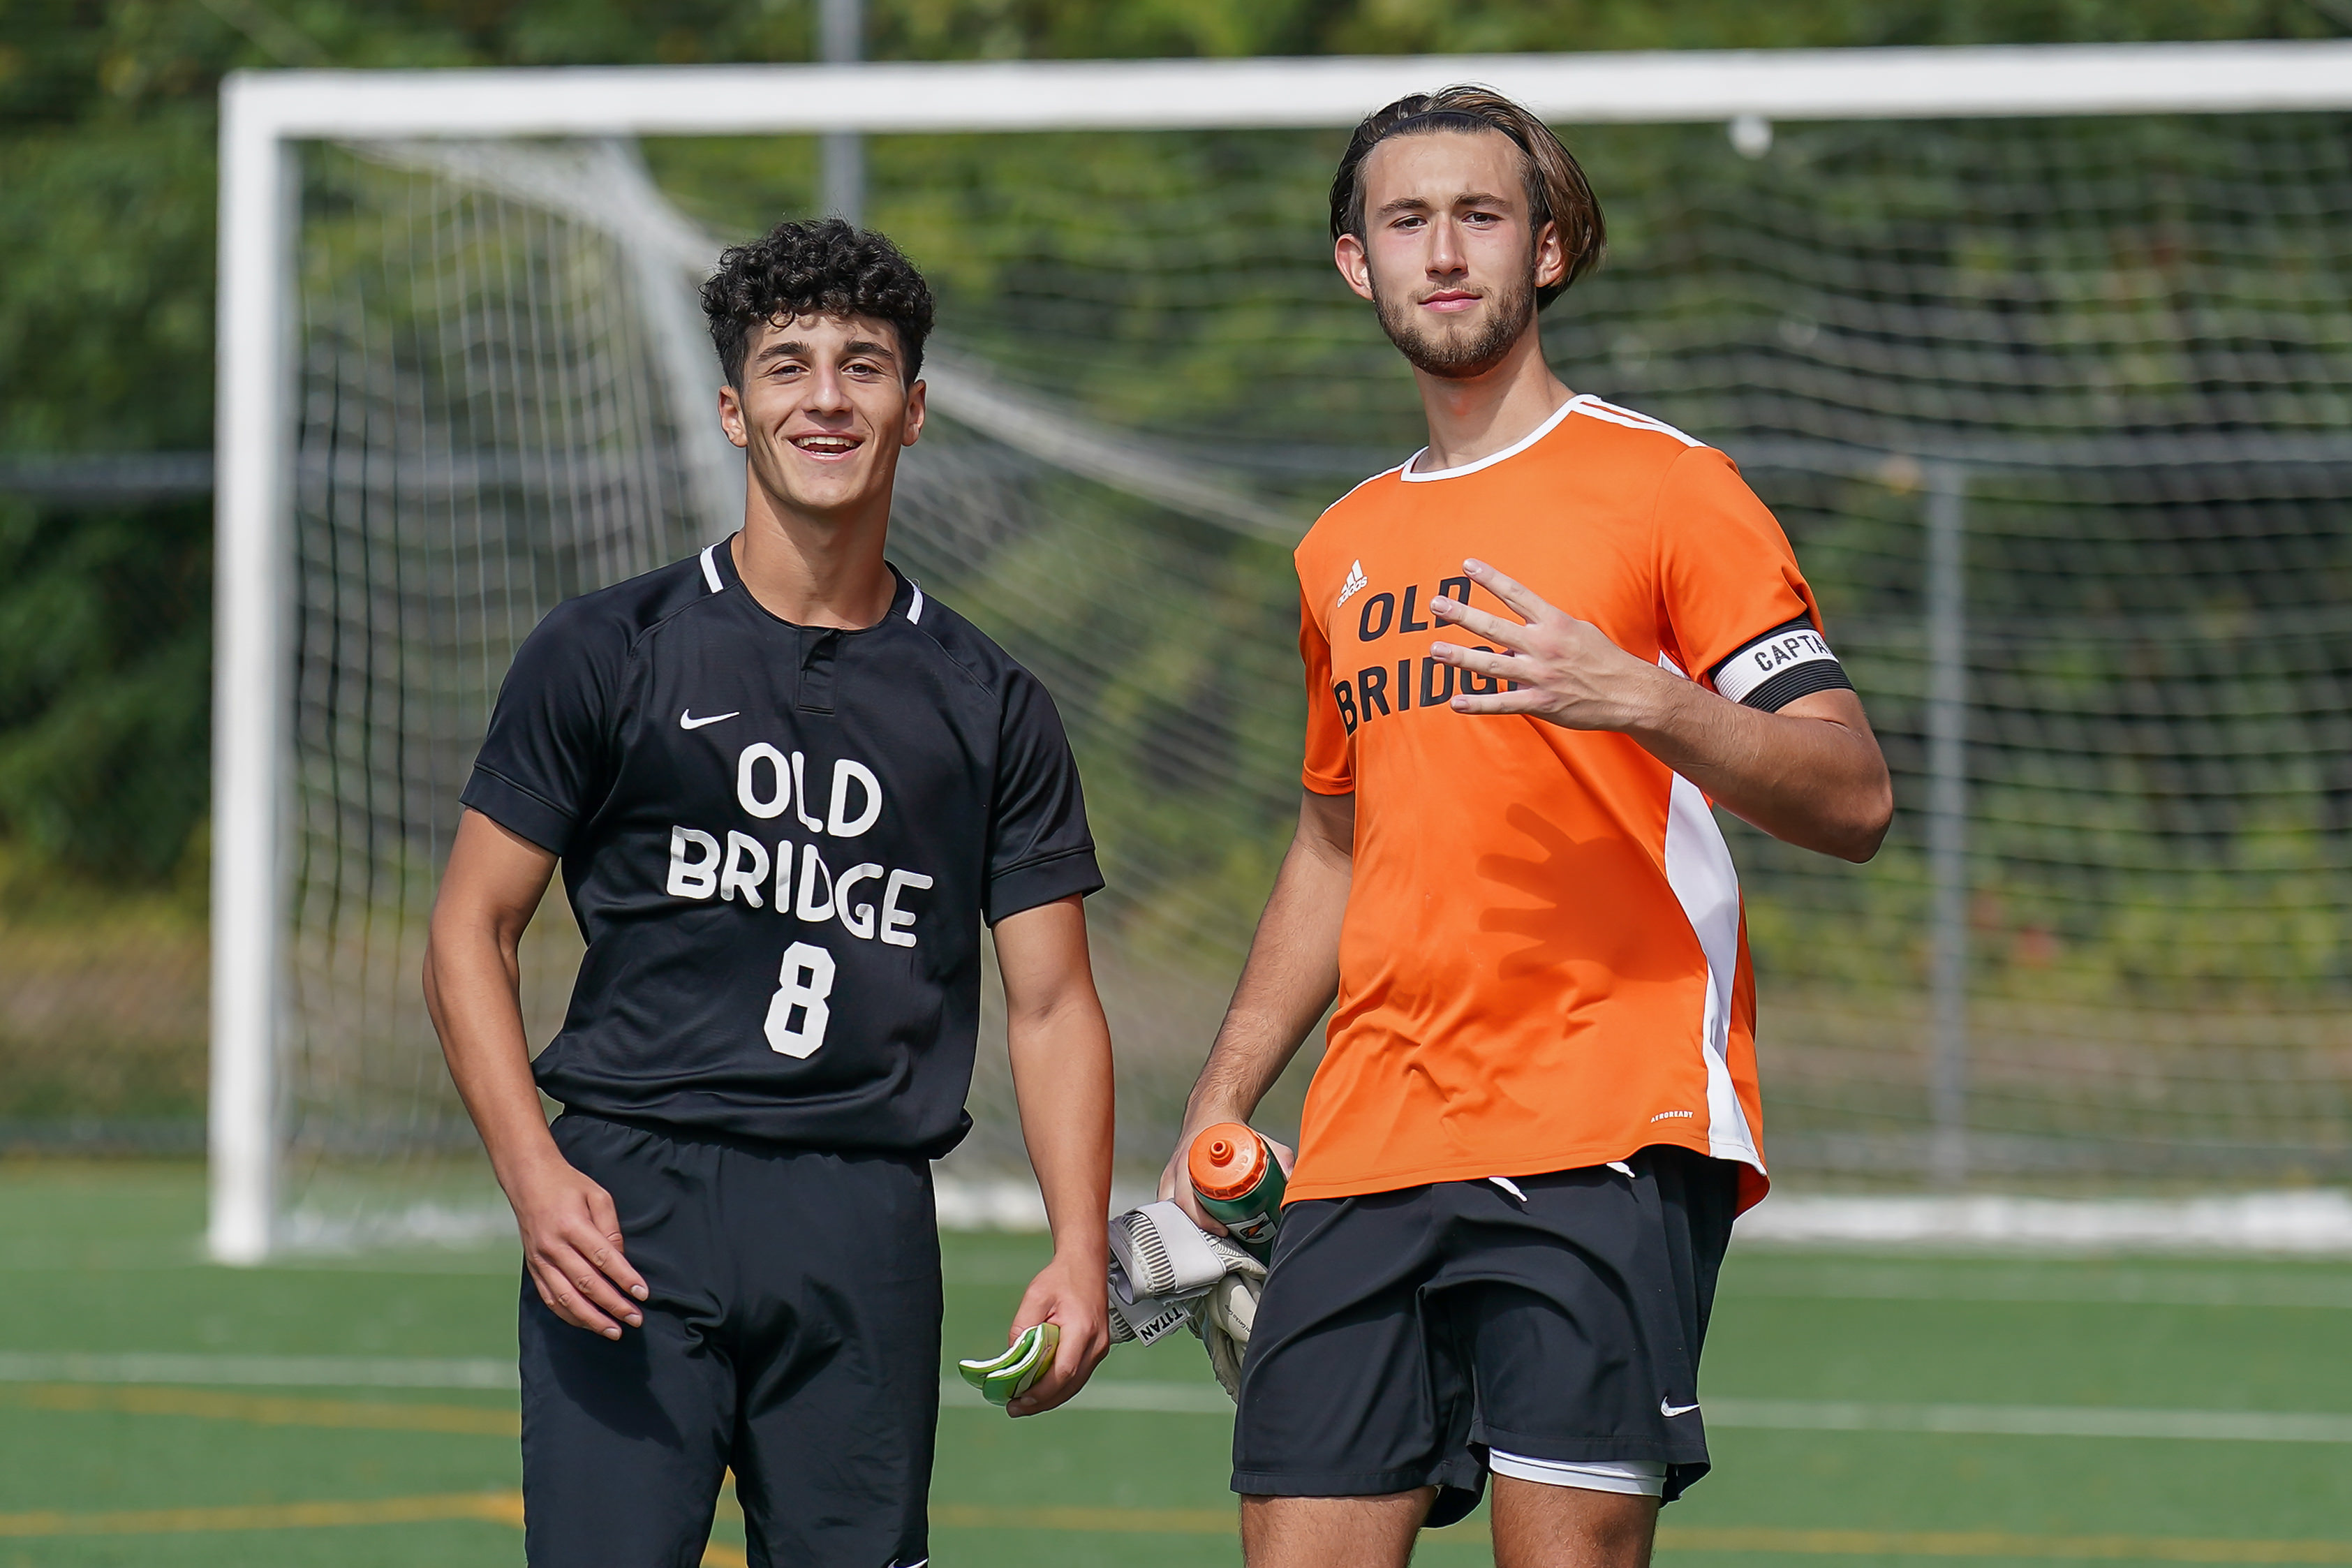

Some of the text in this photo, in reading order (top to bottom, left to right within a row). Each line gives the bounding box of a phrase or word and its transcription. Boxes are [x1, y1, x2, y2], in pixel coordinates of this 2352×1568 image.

[1337, 576, 1368, 608] adidas
[1333, 645, 1518, 737] BRIDG
[1754, 635, 1831, 672] CAPTA
[737, 741, 882, 838] OLD
[666, 824, 934, 948] BRIDGE
[763, 940, 836, 1060] 8
[1650, 1110, 1694, 1123] AEROREADY
